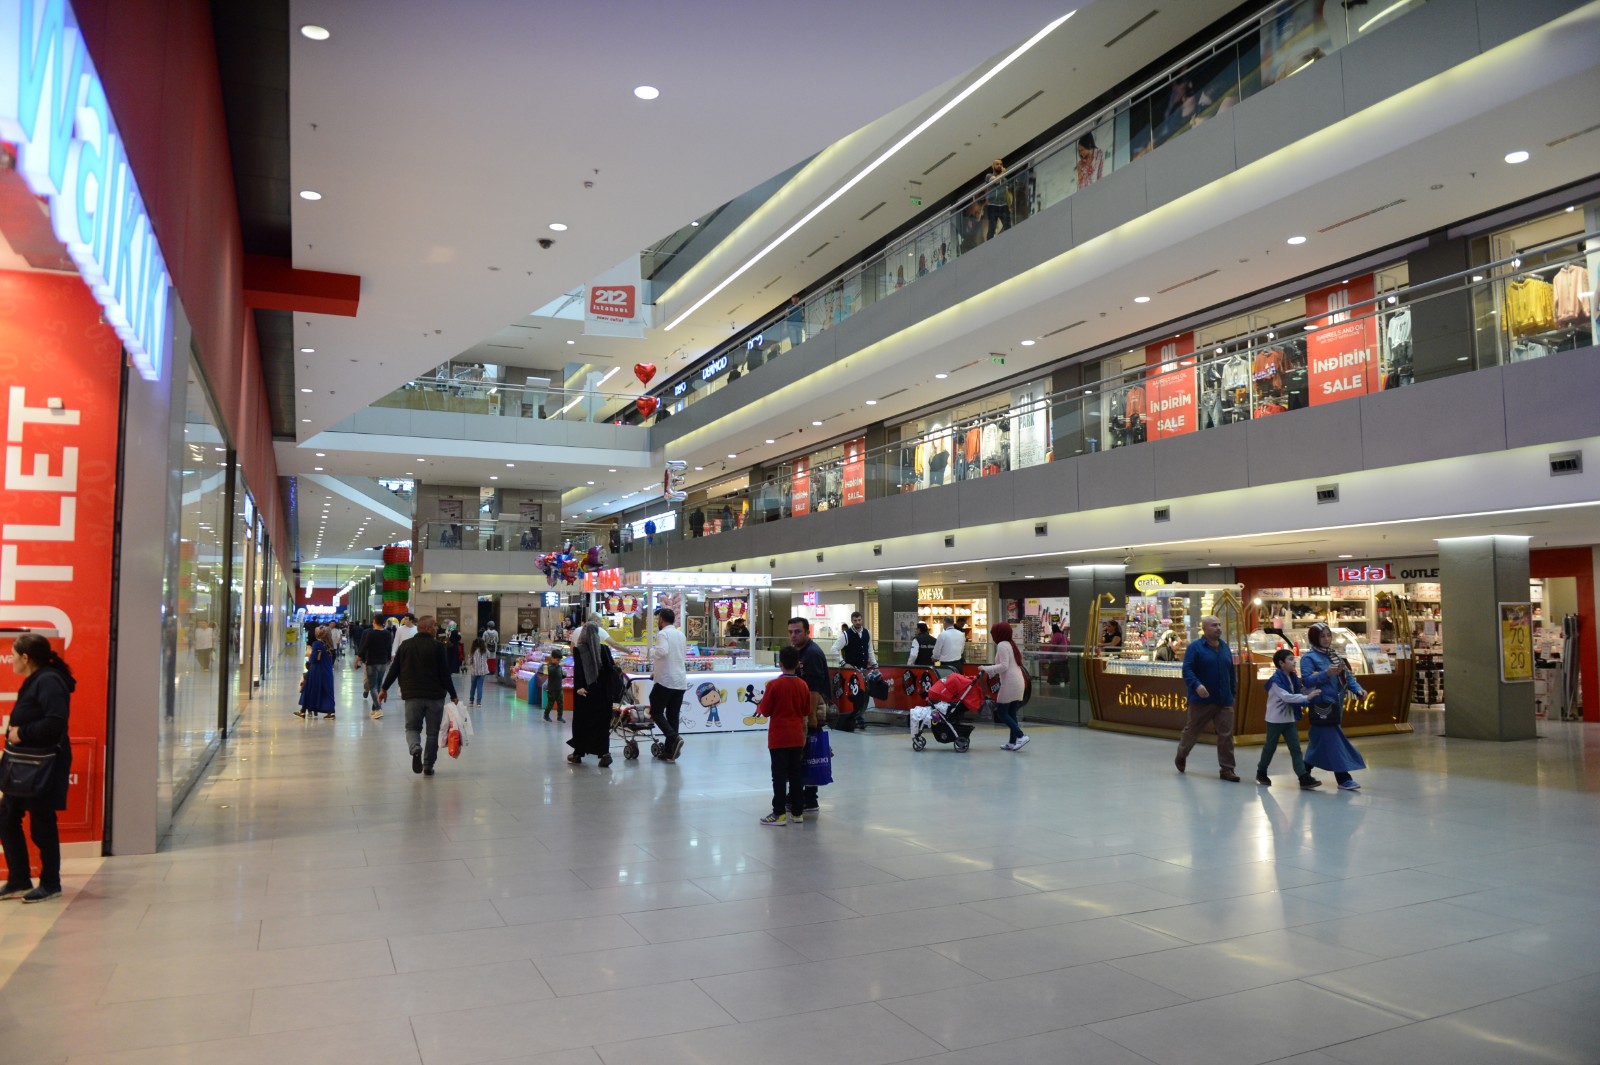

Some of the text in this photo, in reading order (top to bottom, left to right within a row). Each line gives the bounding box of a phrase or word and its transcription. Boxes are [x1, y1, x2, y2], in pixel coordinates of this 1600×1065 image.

[595, 290, 627, 305] 212
[1316, 329, 1342, 342] BARRELS
[1342, 326, 1355, 335] AND
[1323, 374, 1363, 395] SALE
[1019, 413, 1035, 429] PARK
[1157, 415, 1185, 431] SALE
[1335, 563, 1440, 582] Tefal OUTLE
[1137, 576, 1160, 587] gratis
[1509, 627, 1525, 645] 70
[1510, 651, 1526, 670] 20
